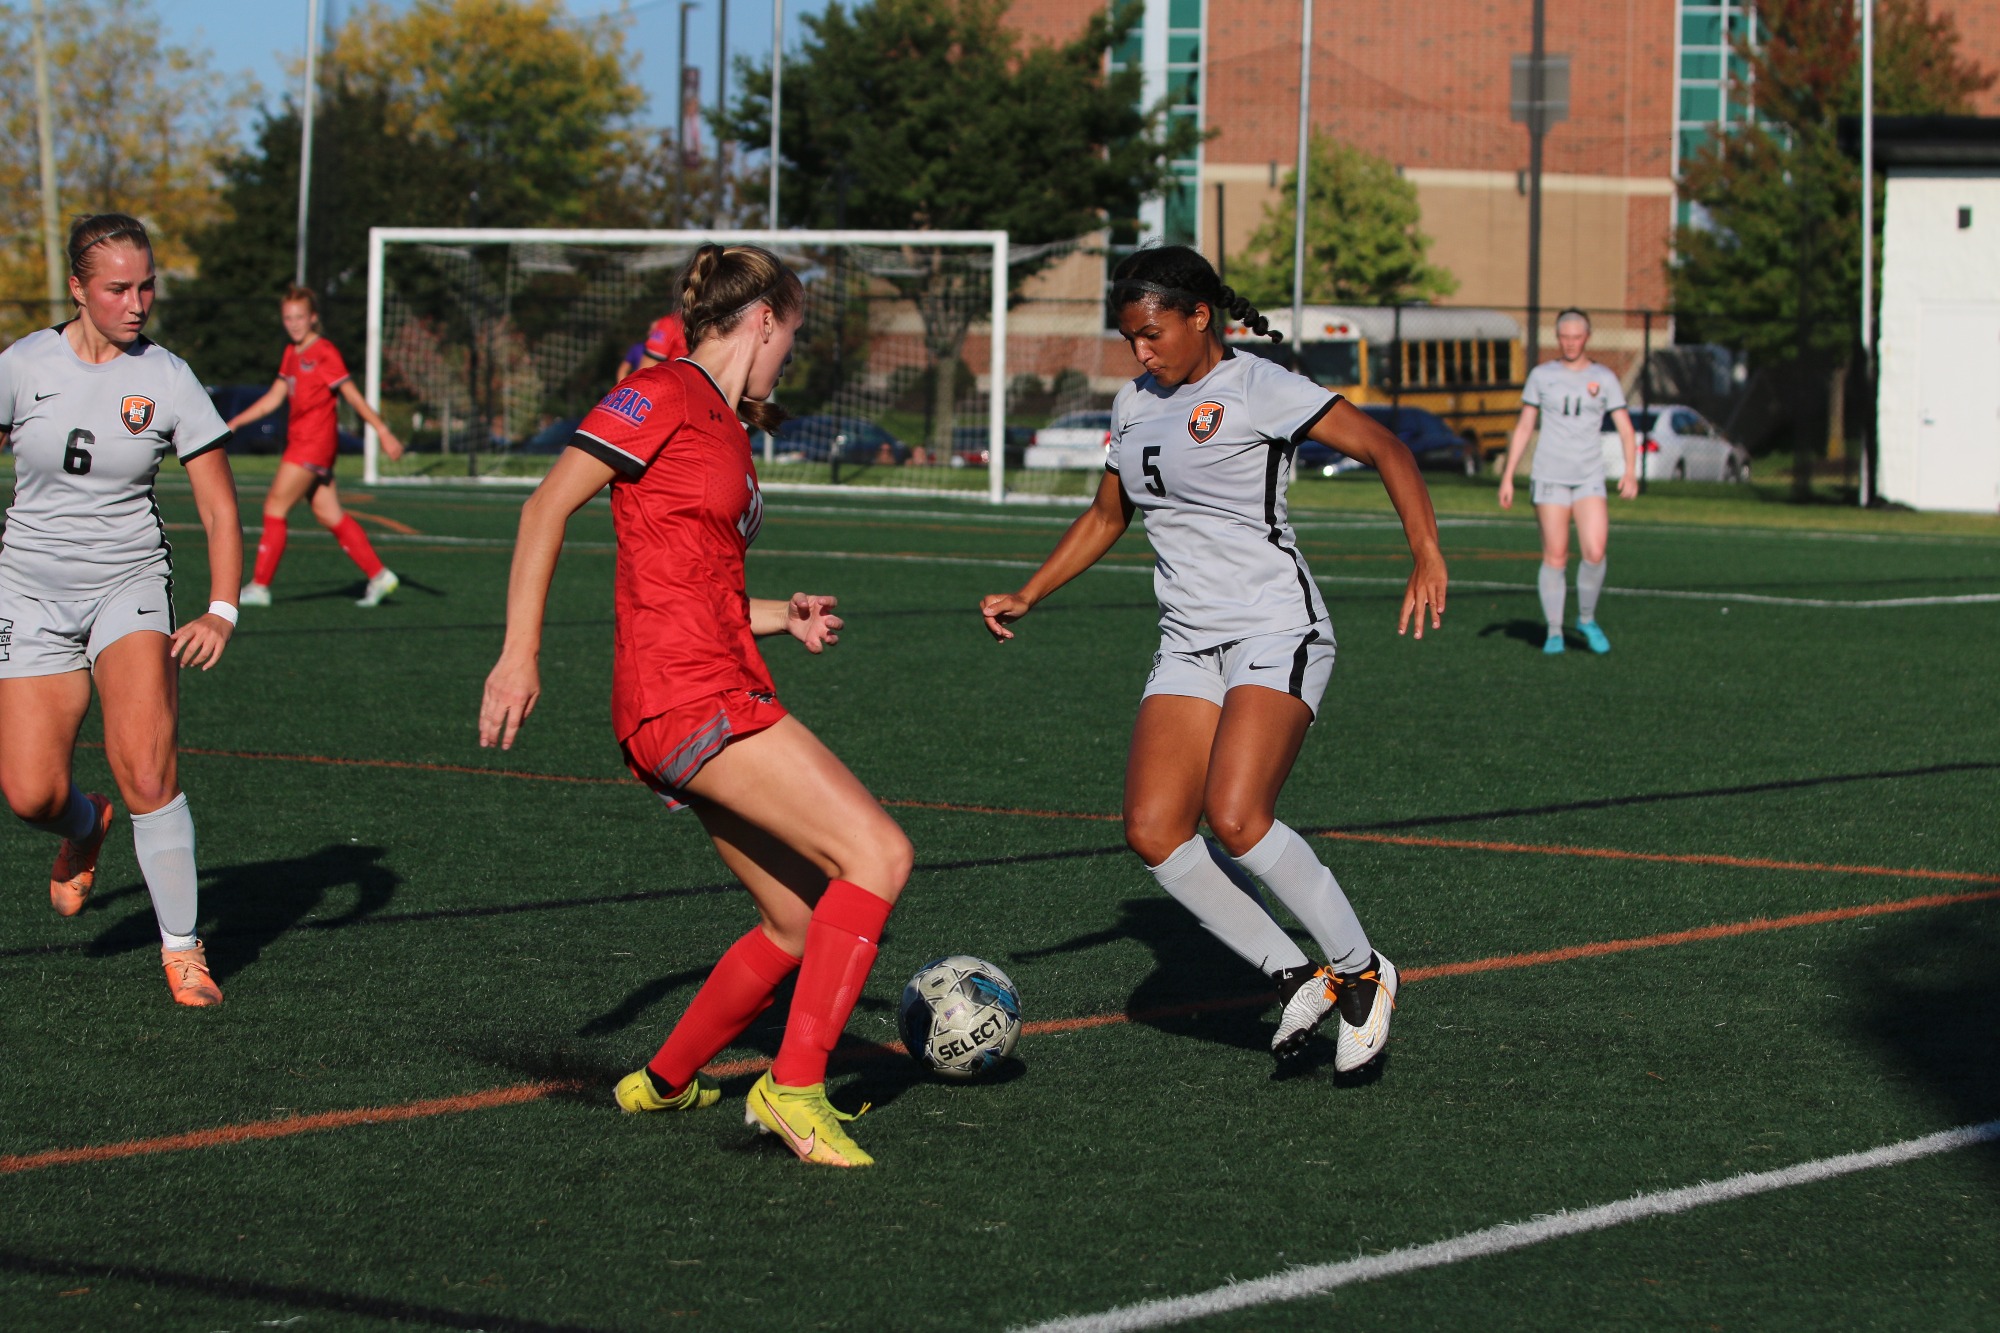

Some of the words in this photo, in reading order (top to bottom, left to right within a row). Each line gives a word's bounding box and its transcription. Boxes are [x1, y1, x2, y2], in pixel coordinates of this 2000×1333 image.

[1563, 395, 1581, 416] 11
[63, 428, 96, 476] 6
[1142, 446, 1167, 498] 5
[938, 1013, 1002, 1060] SELECT
